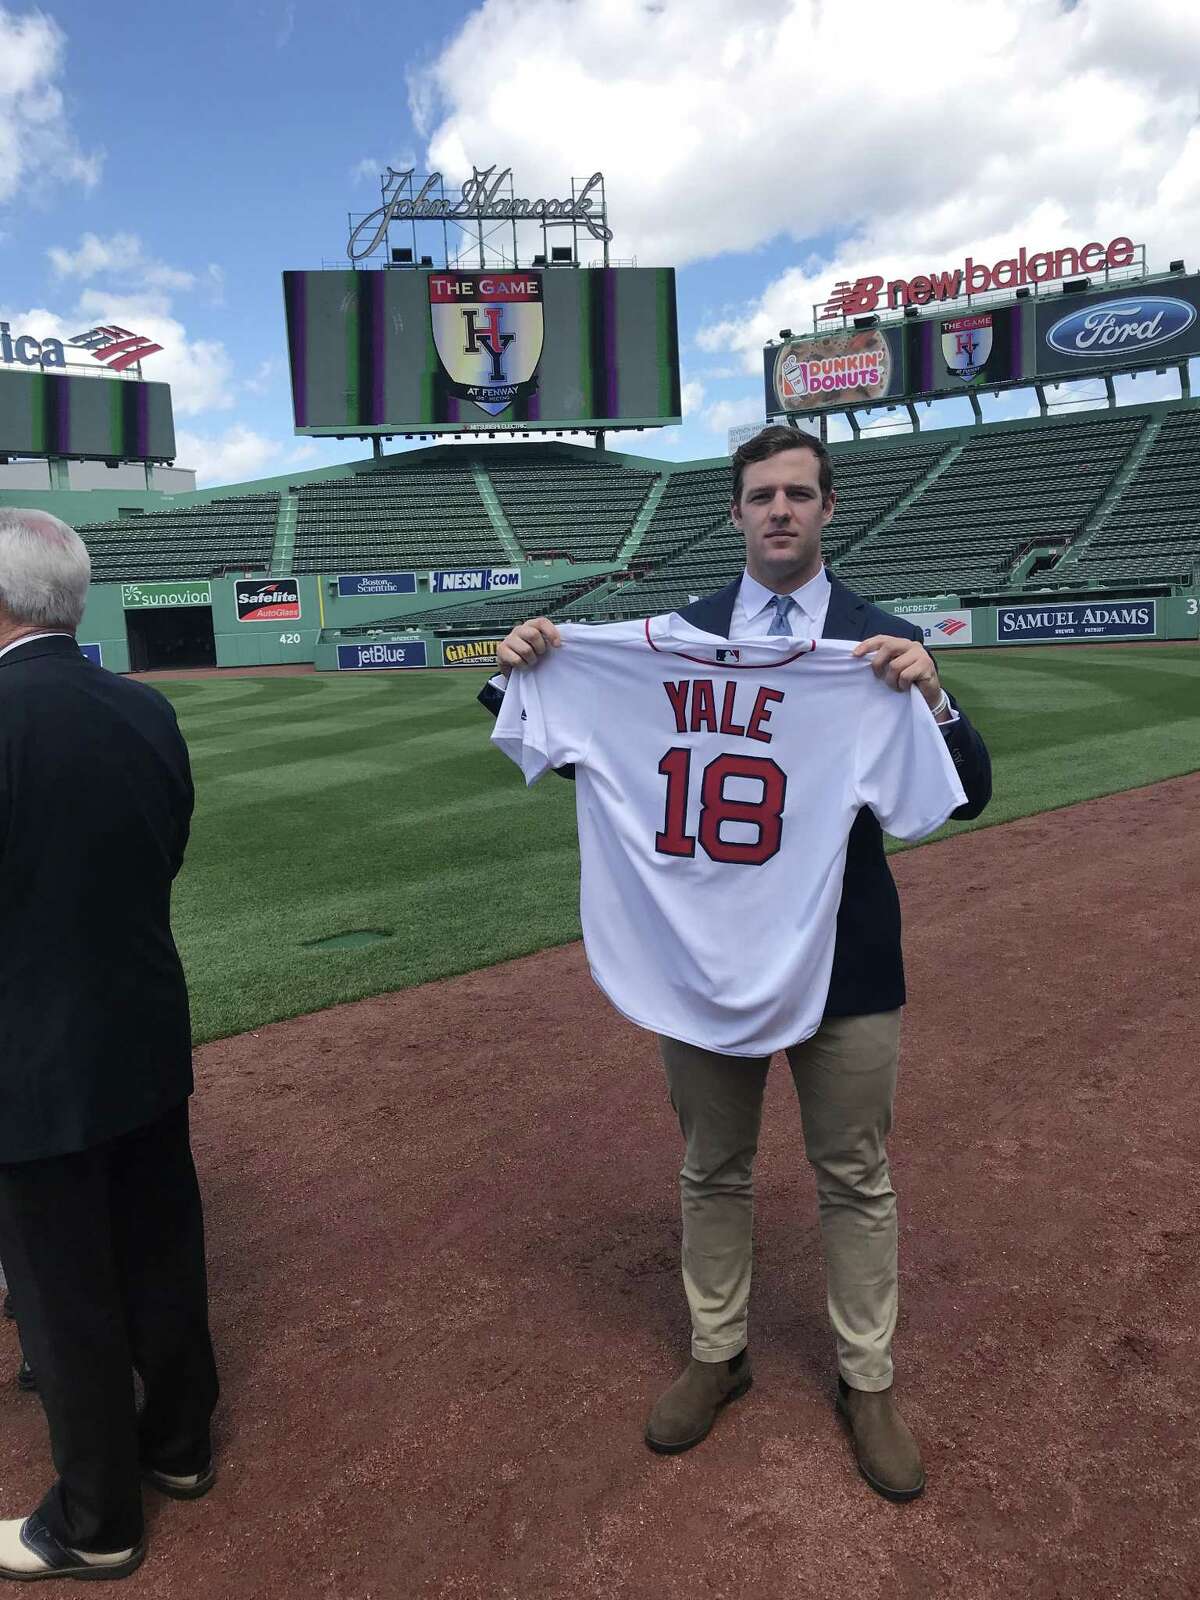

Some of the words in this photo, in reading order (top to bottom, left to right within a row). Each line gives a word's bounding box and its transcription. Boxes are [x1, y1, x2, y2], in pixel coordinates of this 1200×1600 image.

[347, 166, 452, 260] John
[451, 164, 613, 242] Hancock
[431, 280, 474, 295] THE
[479, 279, 539, 295] GAME
[942, 322, 962, 330] THE
[963, 317, 992, 327] GAME
[1075, 306, 1165, 348] Ford
[809, 368, 880, 392] DONUTS
[467, 387, 480, 396] AT
[482, 386, 519, 397] FENWAY
[357, 582, 398, 593] Scientific
[361, 578, 389, 587] Boston
[142, 590, 210, 605] sunovion
[238, 592, 297, 604] Safelite
[256, 609, 298, 617] AutoGlass
[1003, 611, 1079, 632] SAMUEL
[1083, 607, 1150, 626] ADAMS
[279, 633, 301, 644] 420
[358, 645, 406, 667] jetBlue
[445, 640, 499, 662] GRANIT
[663, 679, 785, 744] YALE
[655, 747, 788, 866] 18
